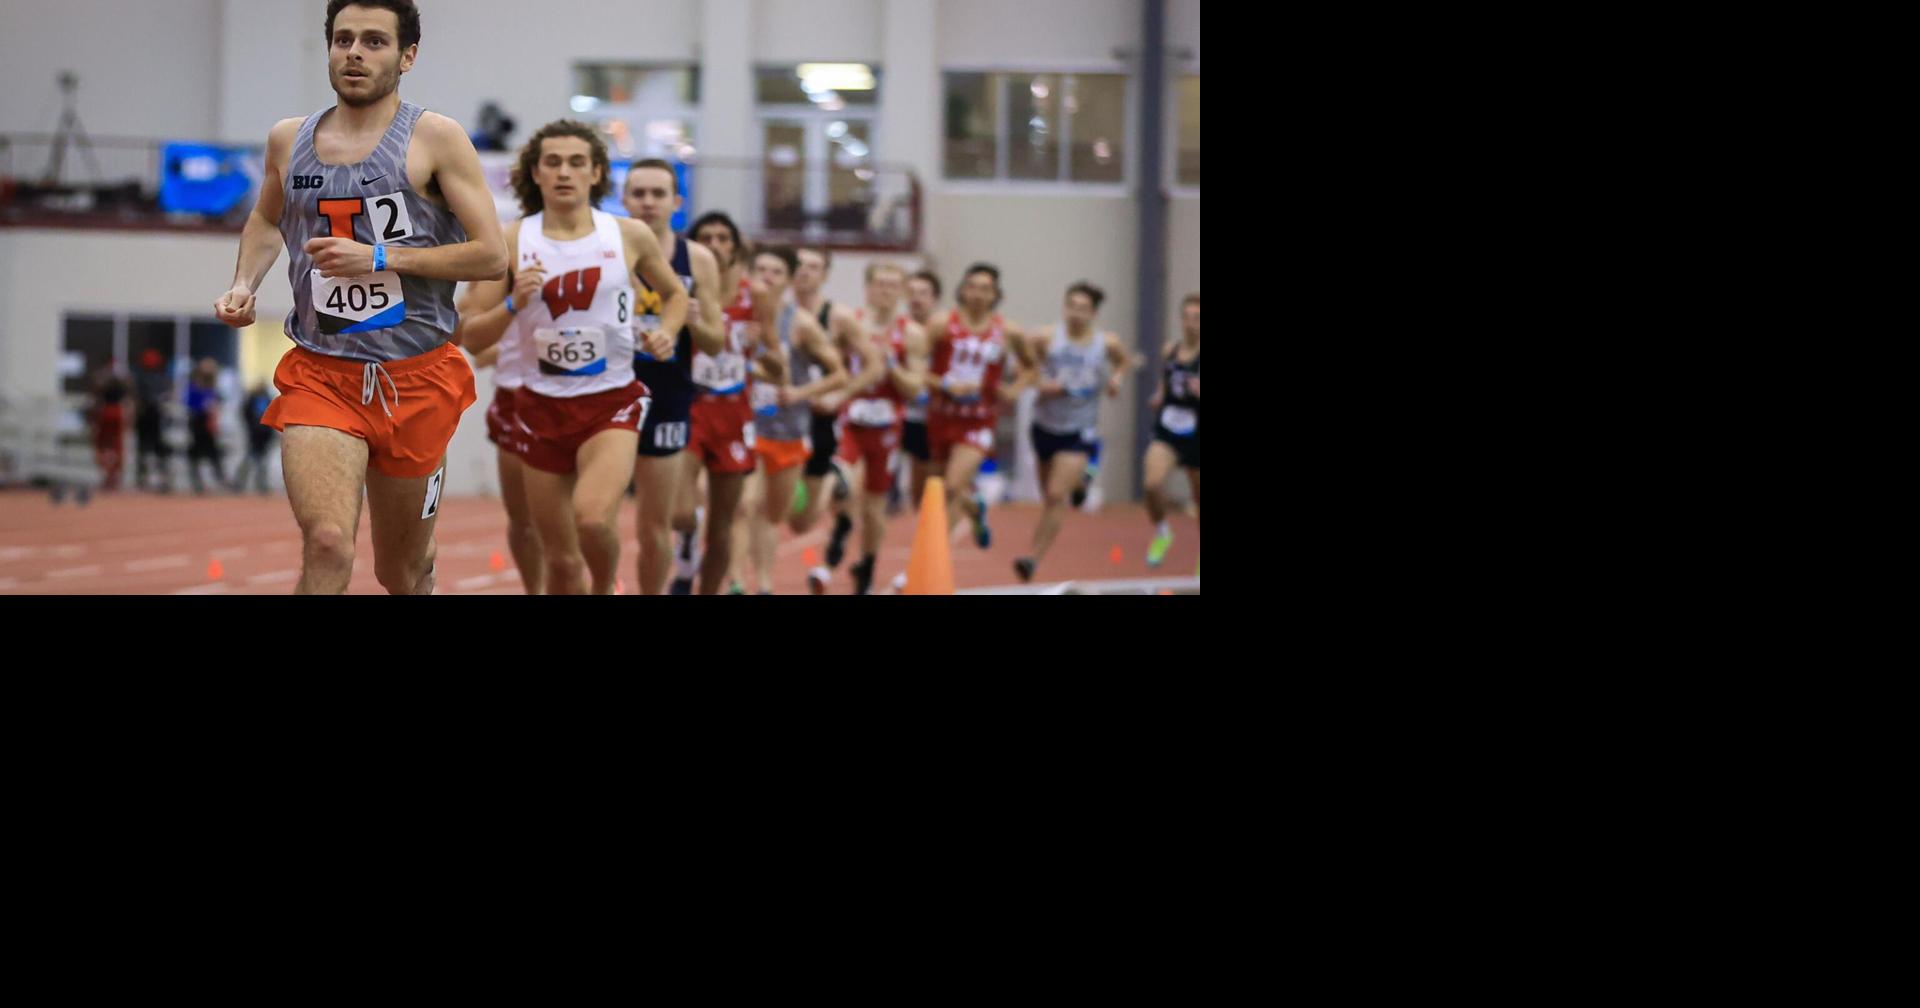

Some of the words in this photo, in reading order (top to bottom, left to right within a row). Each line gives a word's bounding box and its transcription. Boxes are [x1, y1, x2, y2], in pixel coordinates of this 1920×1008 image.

[375, 197, 406, 240] 2
[326, 282, 389, 313] 405
[542, 267, 601, 321] W
[617, 292, 628, 323] 8
[547, 341, 596, 363] 663
[427, 473, 440, 515] 2
